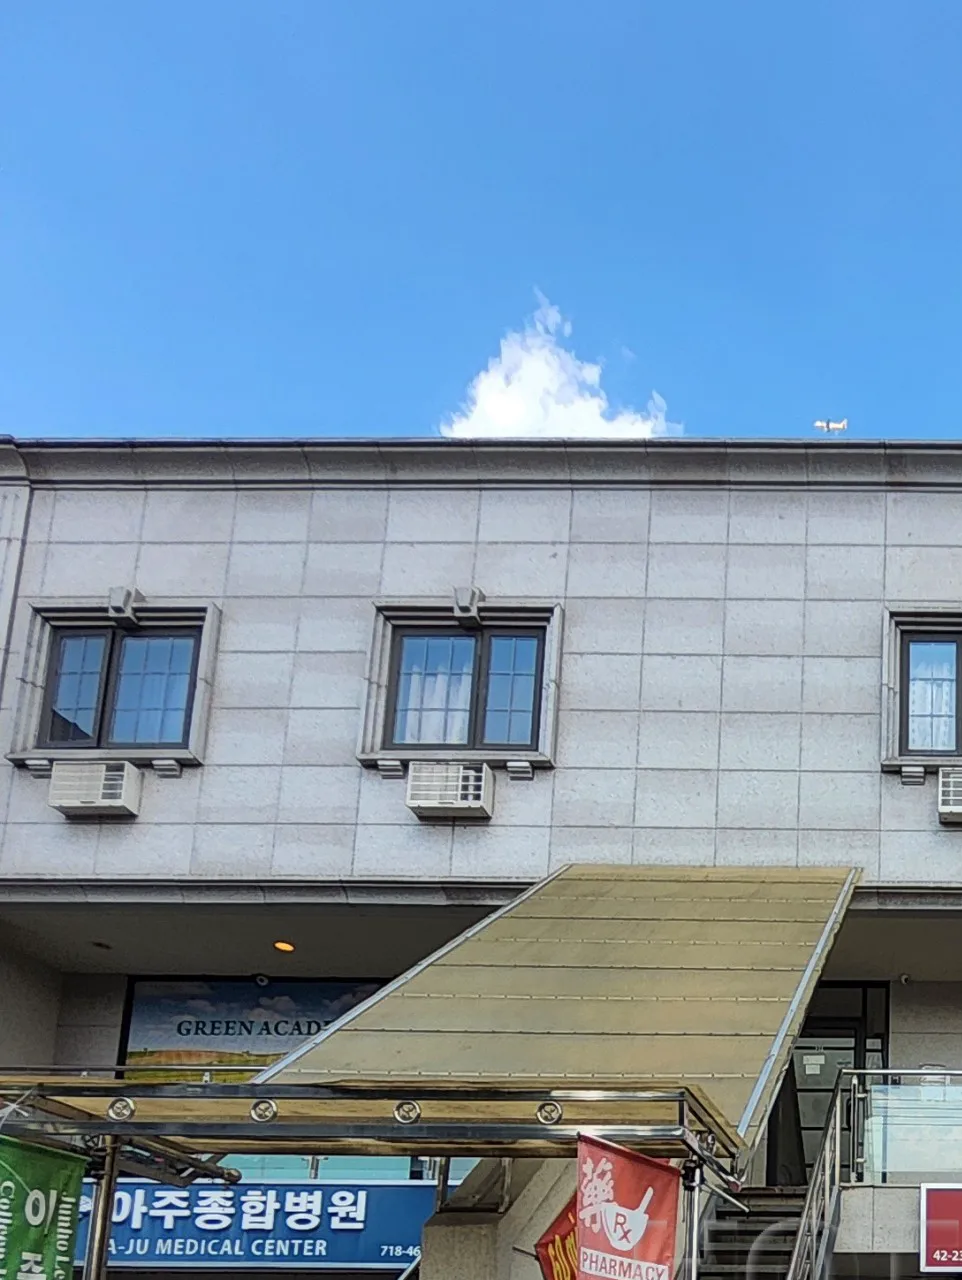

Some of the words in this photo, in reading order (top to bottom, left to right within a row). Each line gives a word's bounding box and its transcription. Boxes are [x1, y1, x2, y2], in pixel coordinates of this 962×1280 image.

[176, 1020, 255, 1037] GREEN
[257, 1020, 333, 1037] ACAD
[112, 1189, 367, 1231] 아주종합병원
[155, 1239, 244, 1256] MEDICAL
[251, 1239, 327, 1256] CENTER
